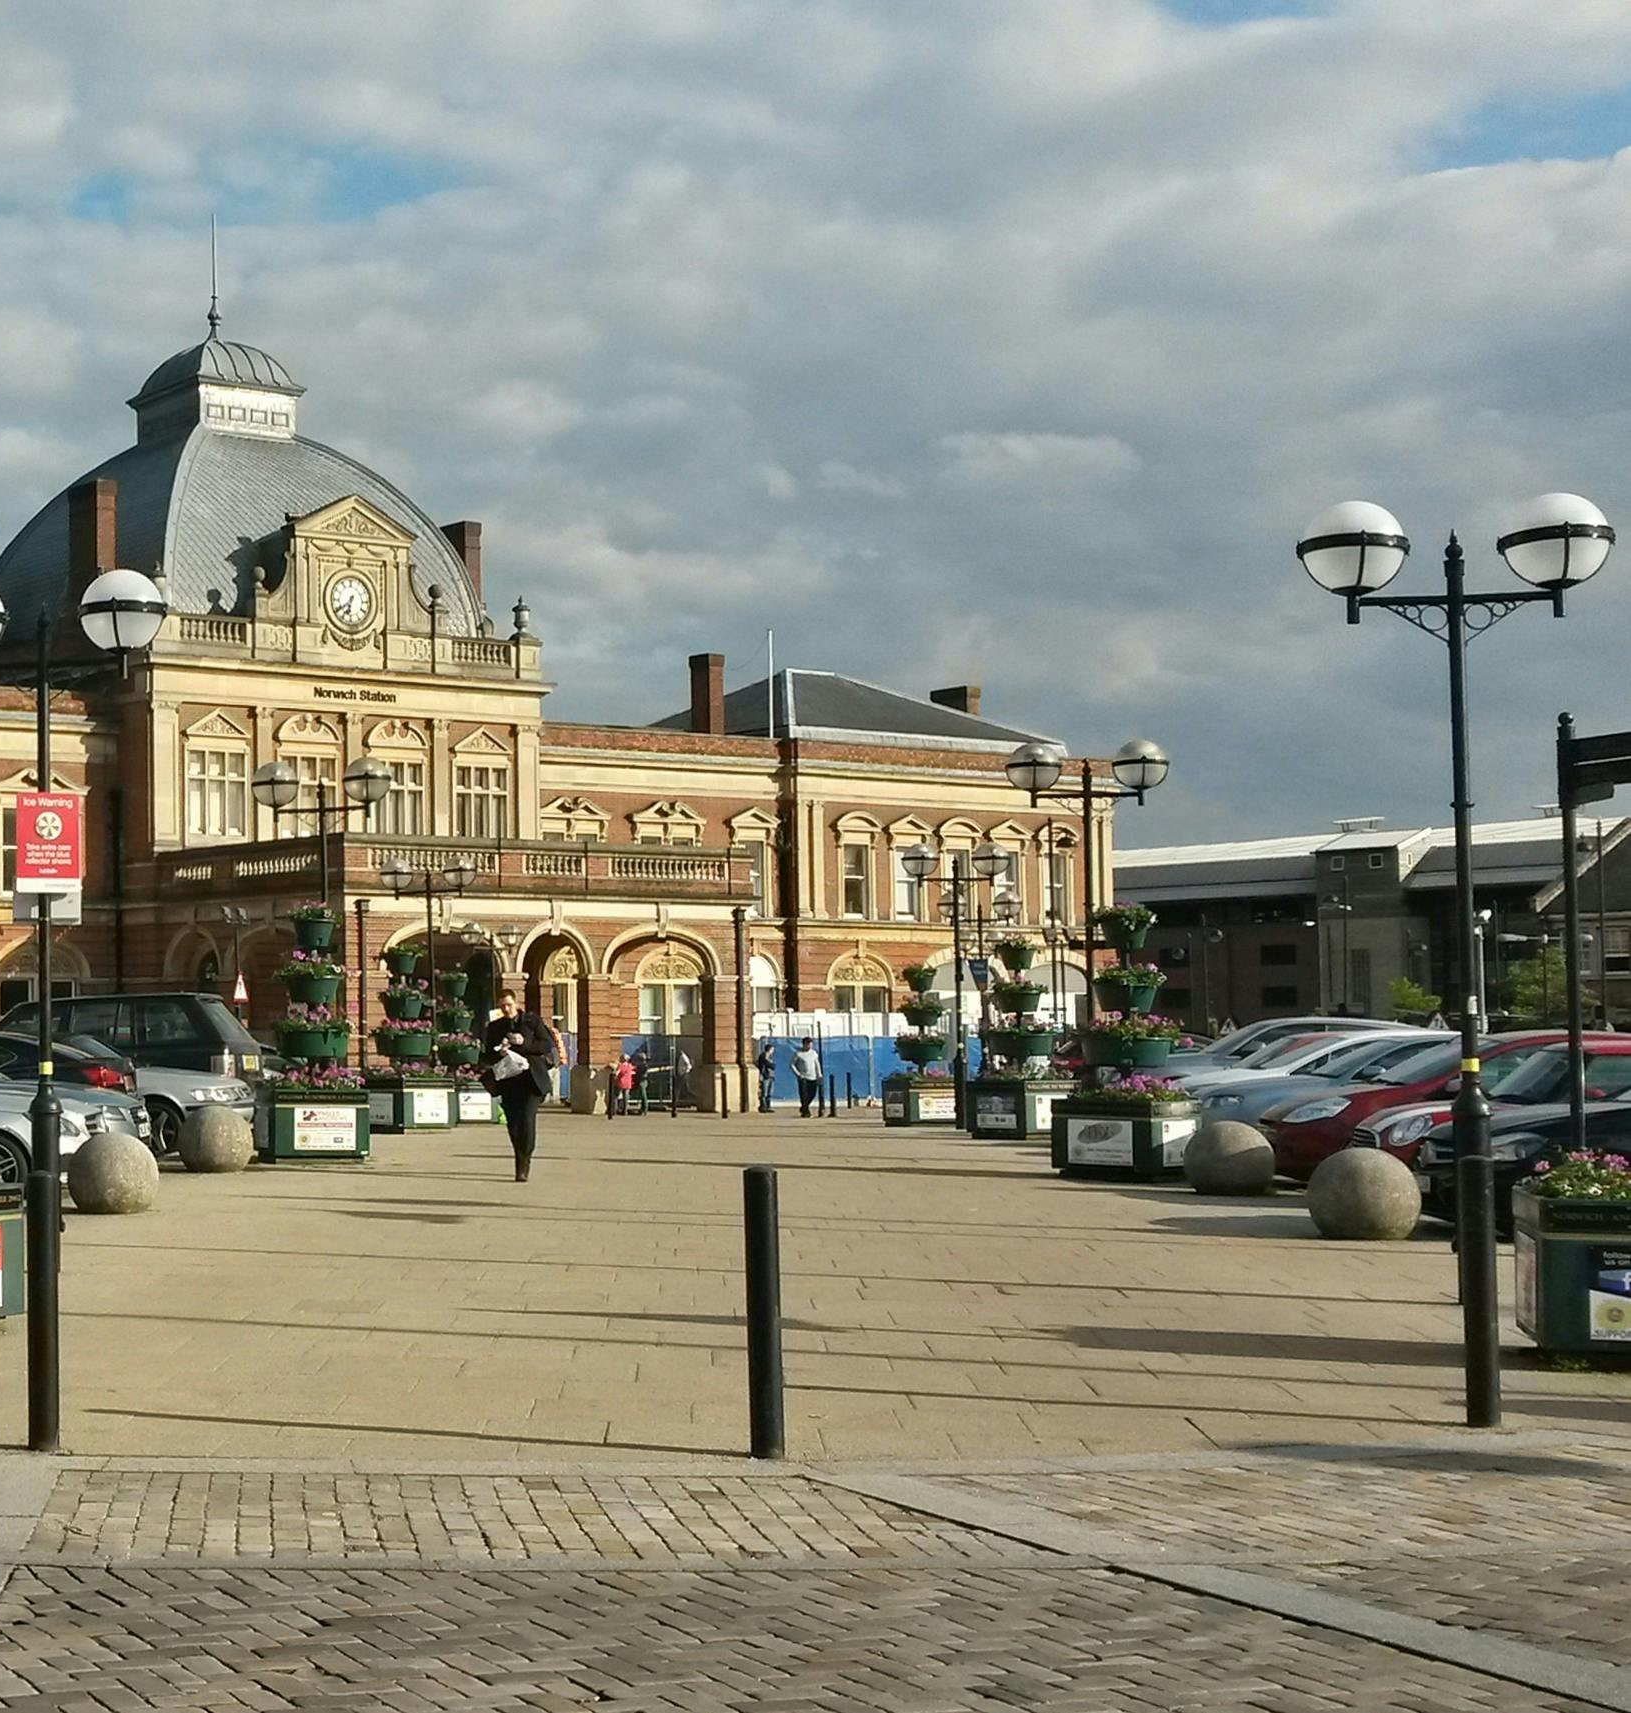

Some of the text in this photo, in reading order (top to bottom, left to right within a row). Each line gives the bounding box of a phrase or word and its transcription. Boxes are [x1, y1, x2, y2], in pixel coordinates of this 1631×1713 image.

[313, 686, 396, 703] Norwich Station
[23, 797, 73, 809] Ice Warning
